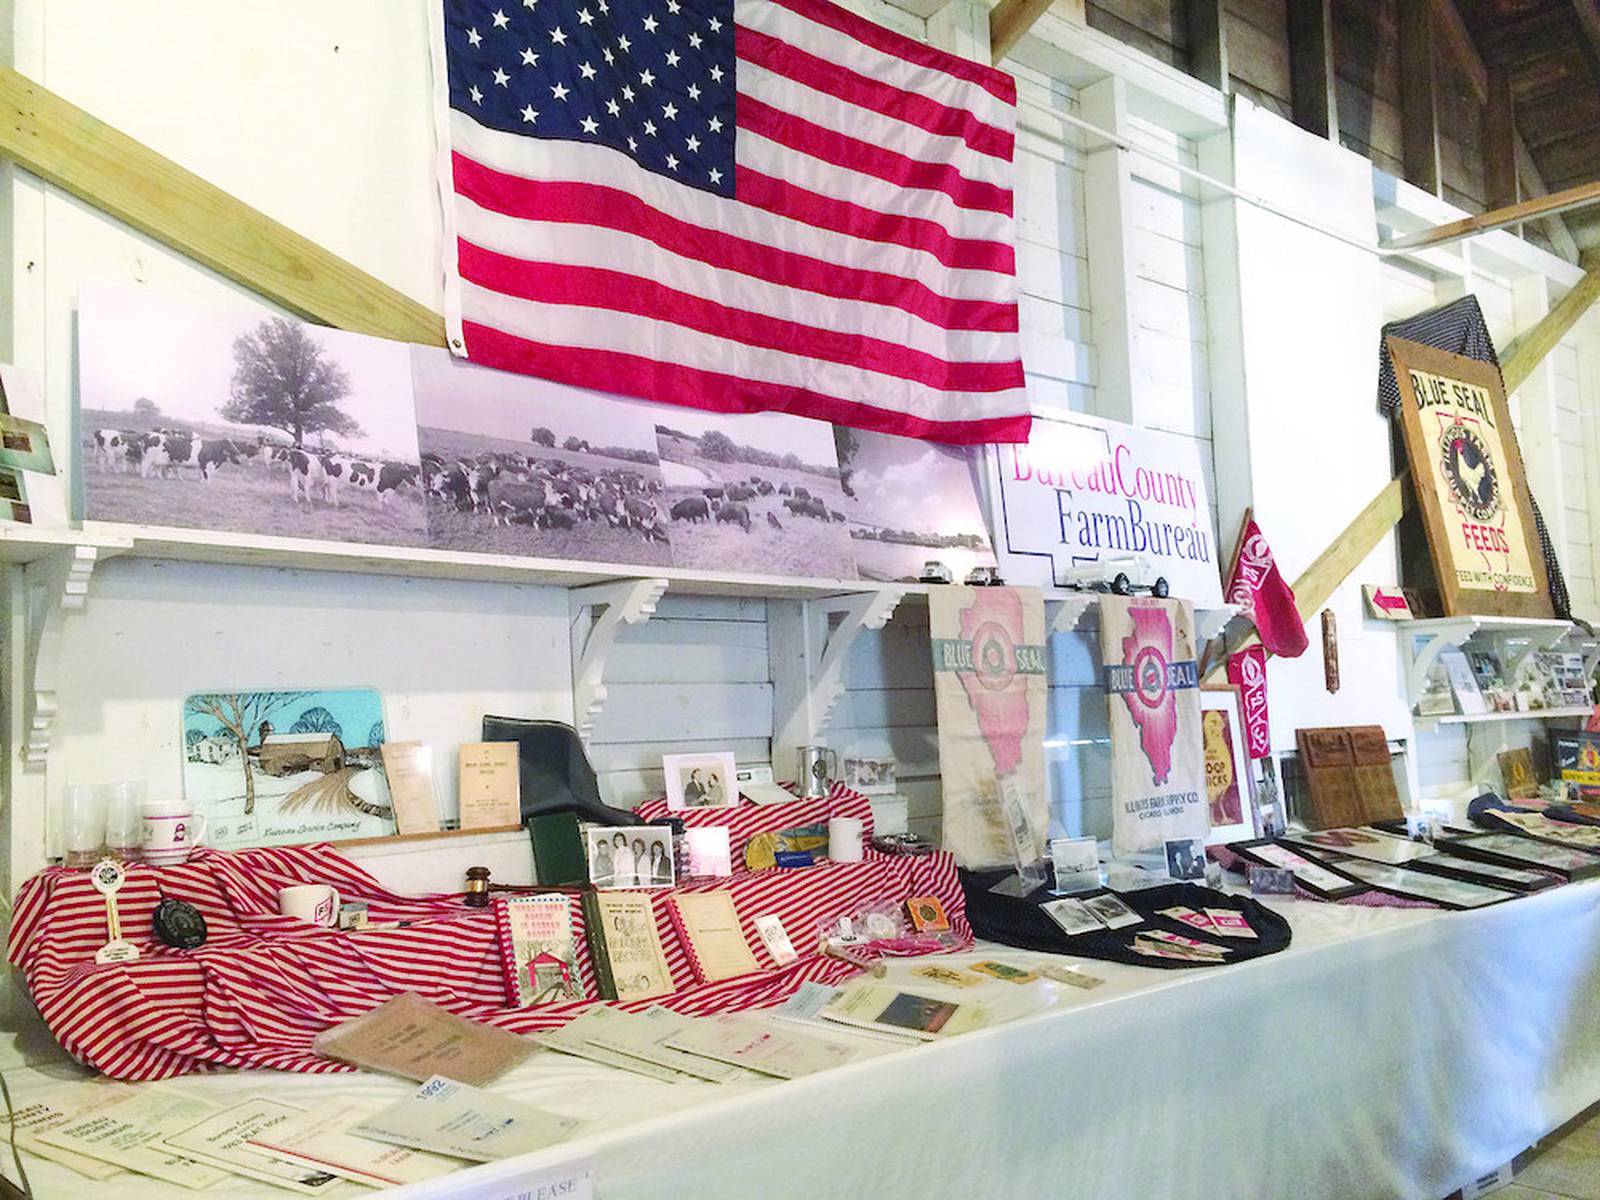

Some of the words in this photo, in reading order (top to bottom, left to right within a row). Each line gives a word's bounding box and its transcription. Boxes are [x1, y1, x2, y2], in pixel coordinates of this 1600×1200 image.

[1410, 374, 1451, 411] BLUE
[1455, 380, 1496, 430] SEAL
[1461, 522, 1510, 554] FEEDS
[943, 642, 974, 668] BLUE
[1015, 648, 1047, 671] SEAL
[1111, 668, 1134, 690] BLUE
